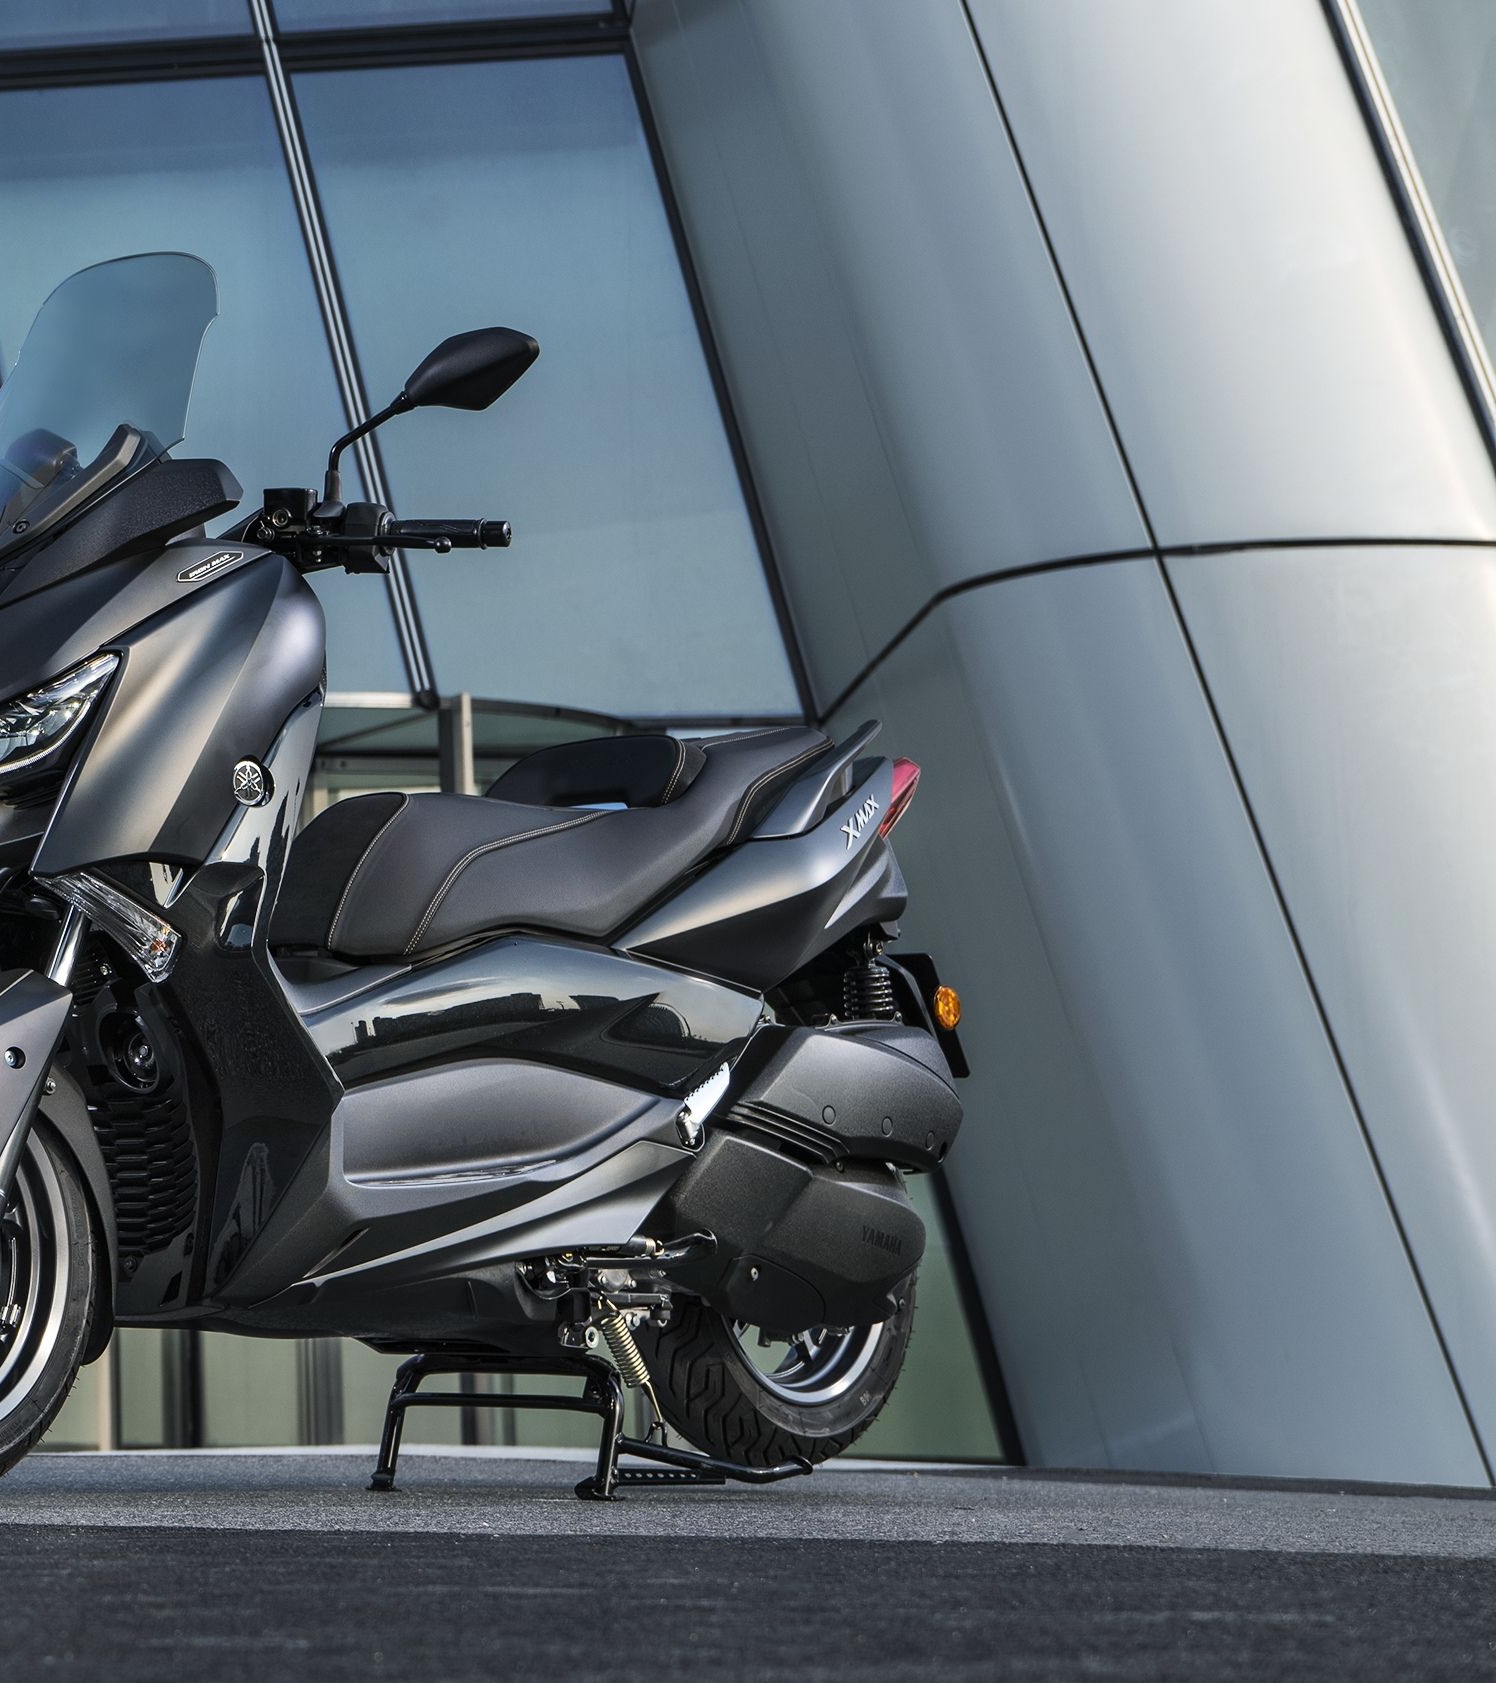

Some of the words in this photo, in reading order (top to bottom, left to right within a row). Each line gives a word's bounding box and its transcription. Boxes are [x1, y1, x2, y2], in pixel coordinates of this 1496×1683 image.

[188, 562, 211, 578] IRON
[211, 553, 231, 567] MAX
[862, 1225, 902, 1256] YAMAHA
